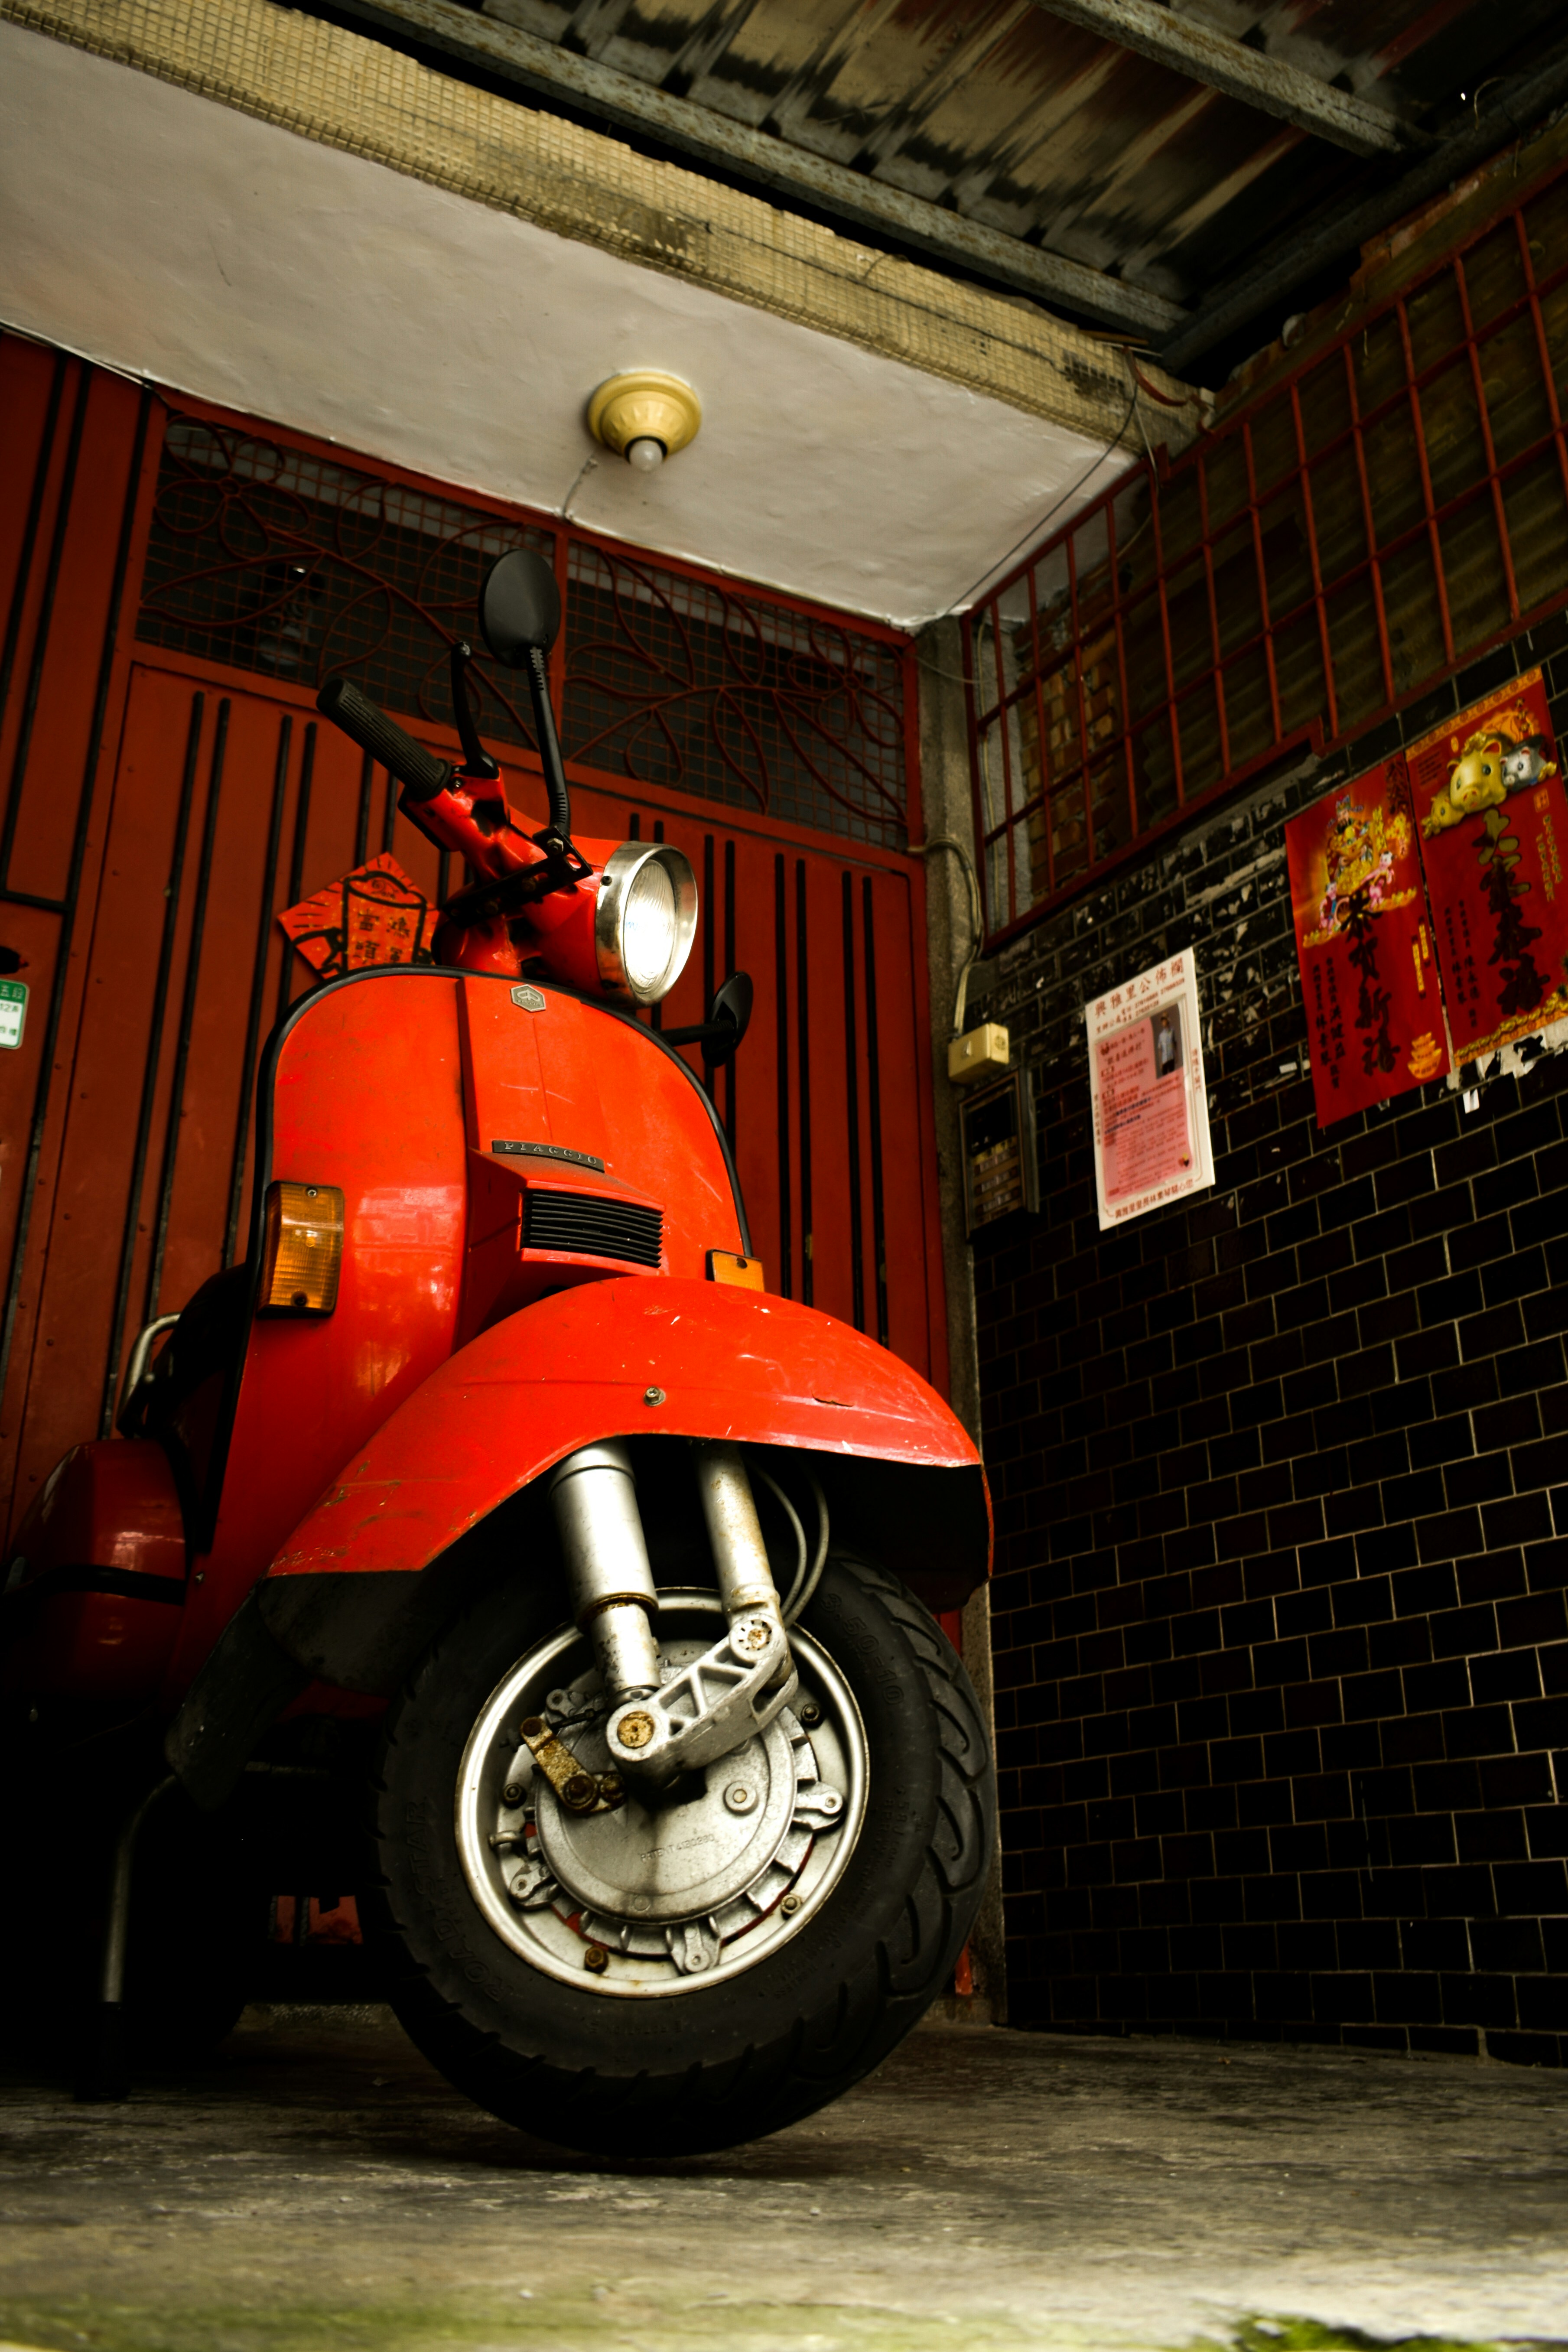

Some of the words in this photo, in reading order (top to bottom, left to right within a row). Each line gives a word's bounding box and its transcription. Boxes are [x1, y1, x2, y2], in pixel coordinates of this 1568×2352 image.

[1095, 957, 1184, 1018] 興雅里公佈欄
[504, 1142, 597, 1166] PIAGGIO
[816, 1588, 908, 1708] 3.50-10
[403, 1801, 441, 1899] STAR
[639, 1845, 673, 1862] PATENT
[430, 1915, 514, 2006] ROAD
